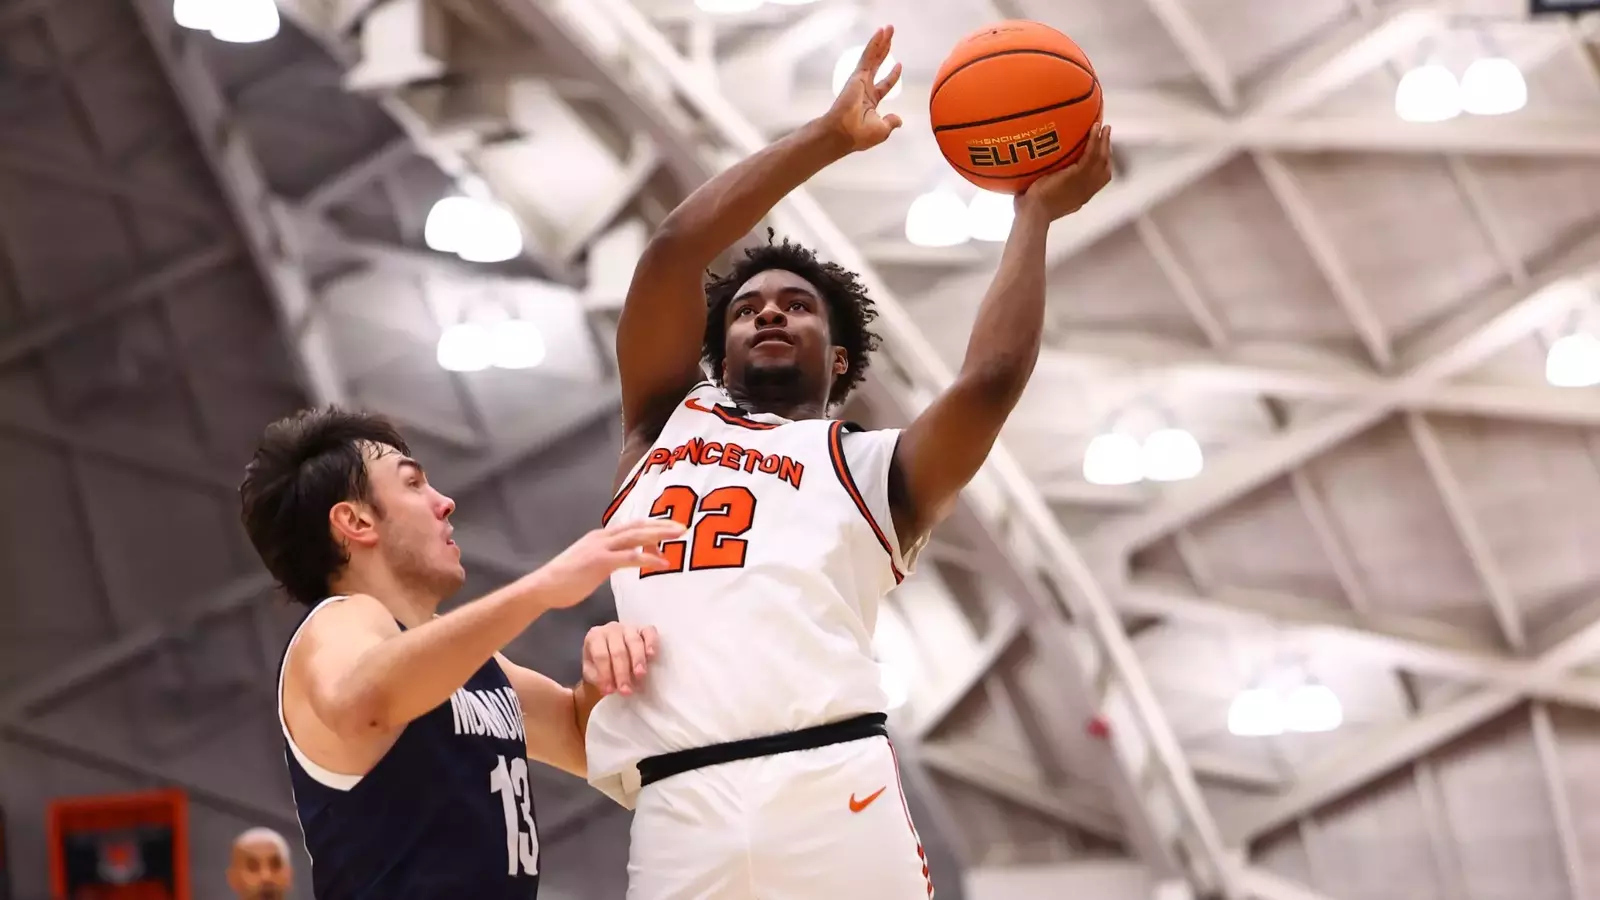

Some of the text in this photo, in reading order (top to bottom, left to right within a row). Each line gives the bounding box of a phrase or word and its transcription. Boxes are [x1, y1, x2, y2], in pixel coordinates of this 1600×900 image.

[967, 129, 1061, 167] ELITE
[644, 436, 805, 490] PRNCETON
[639, 484, 757, 580] 22
[490, 754, 539, 876] 13
